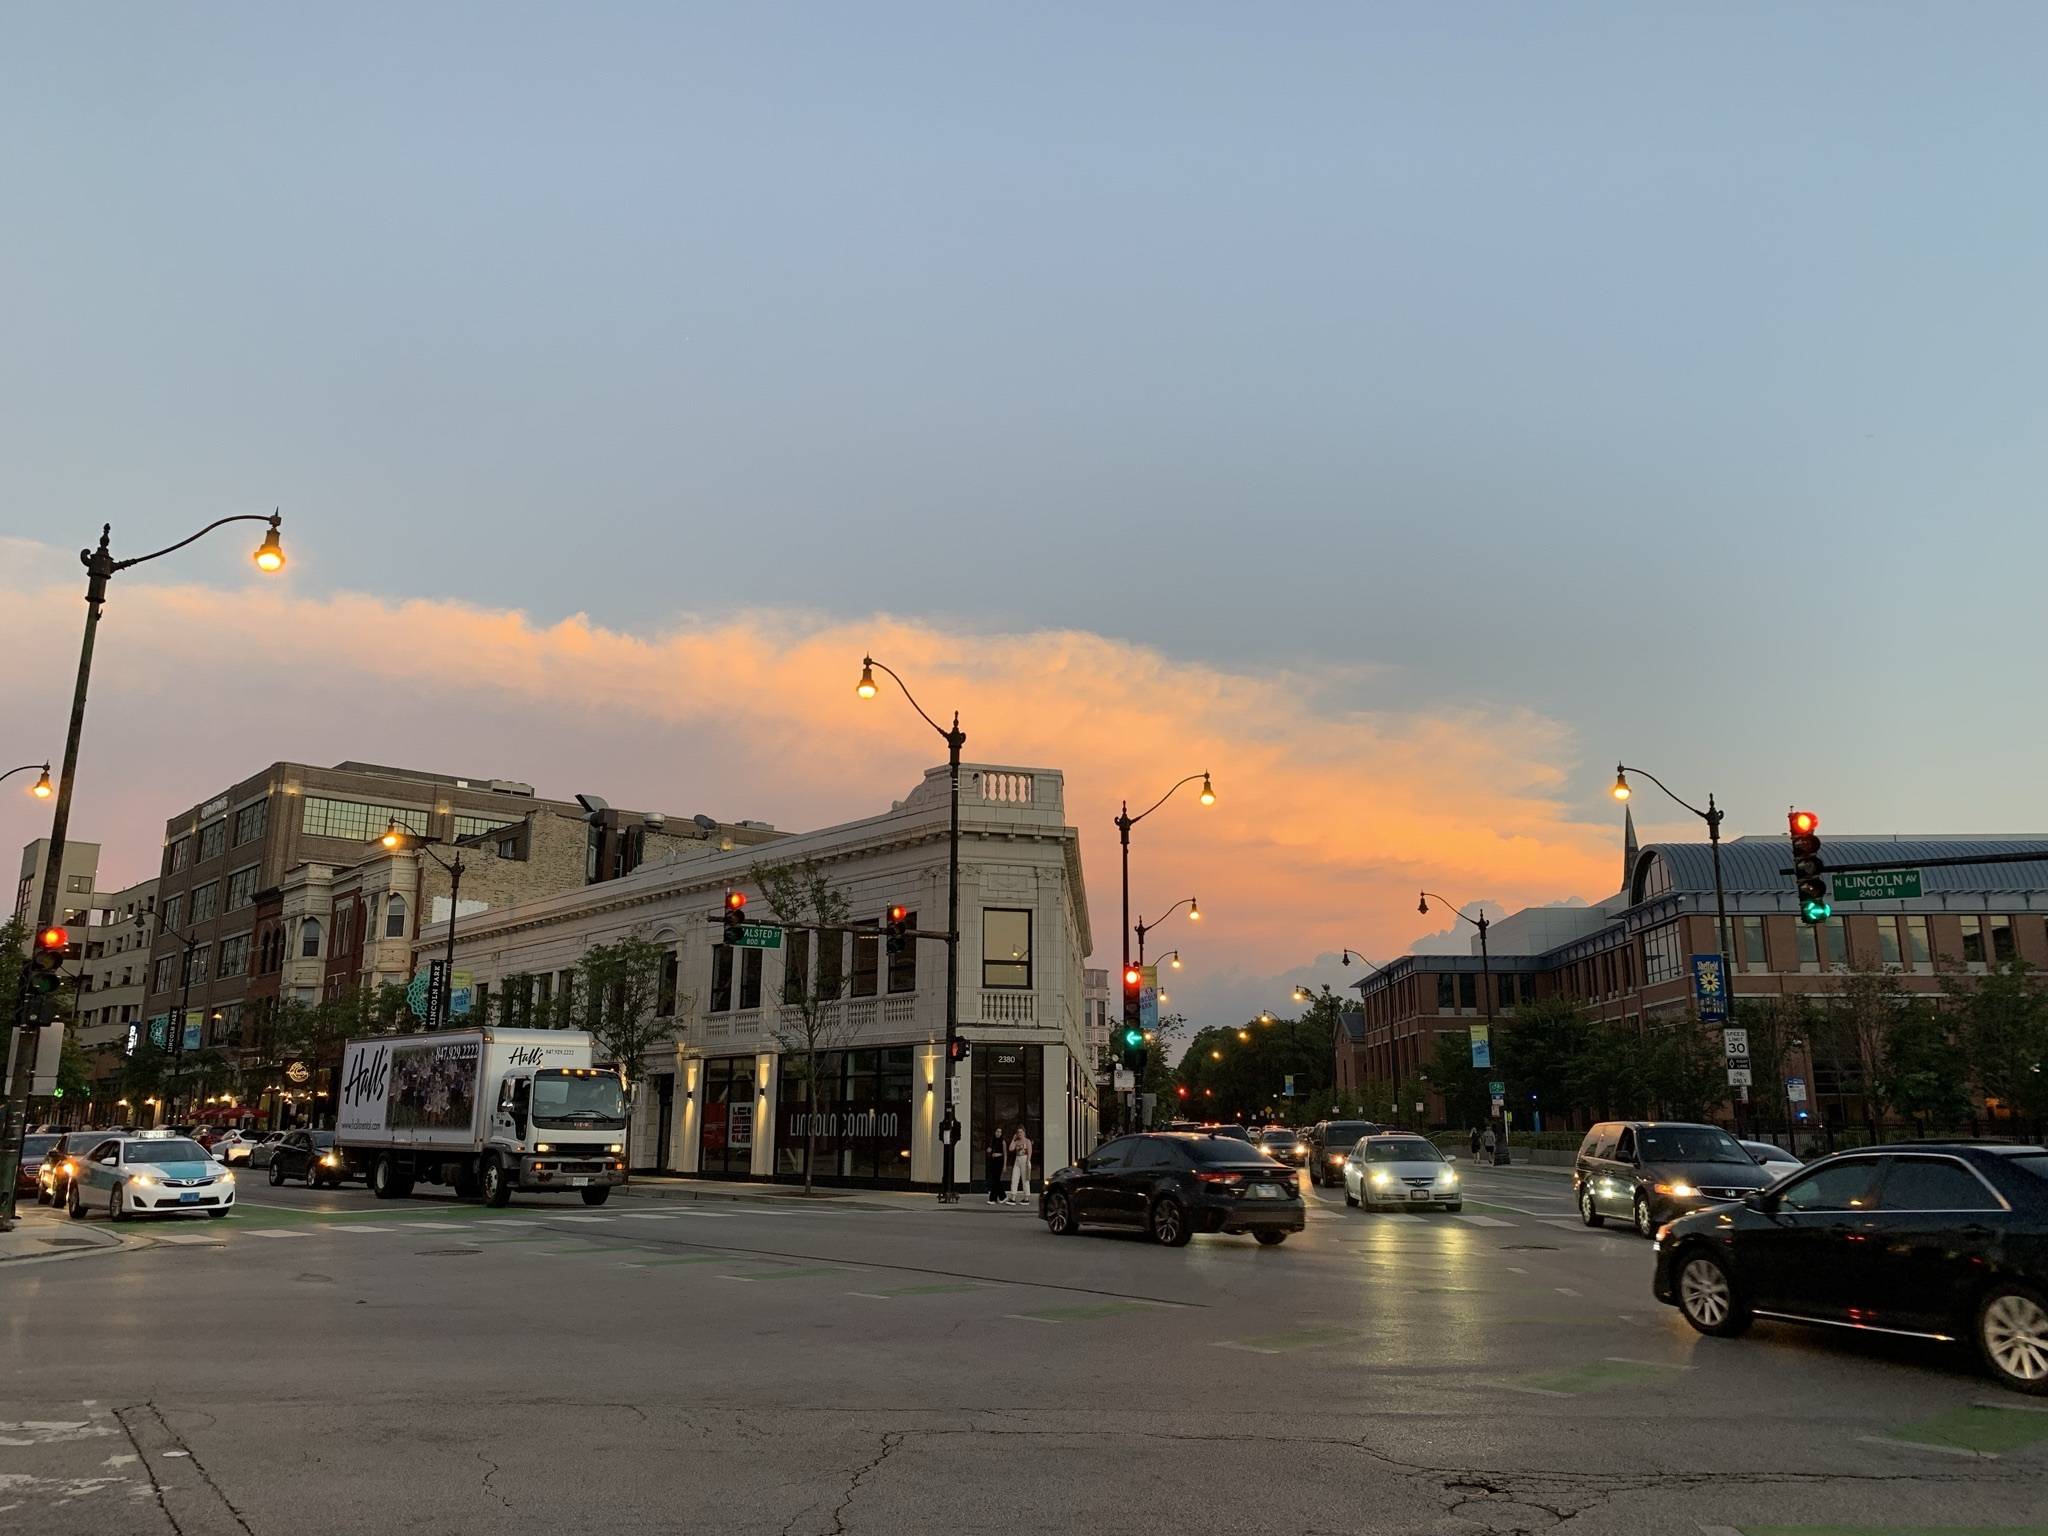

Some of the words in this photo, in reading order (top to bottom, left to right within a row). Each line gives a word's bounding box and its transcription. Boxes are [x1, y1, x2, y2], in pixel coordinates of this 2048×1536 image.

[1835, 879, 1841, 887] N
[1844, 875, 1903, 888] LINCOLN
[1905, 874, 1917, 883] AV
[1859, 889, 1883, 897] 2400
[743, 928, 773, 939] ALSTED
[433, 965, 441, 987] PARK
[430, 988, 439, 1026] LINCOLN
[167, 1027, 176, 1053] LINCOLN
[1728, 1043, 1746, 1054] 30
[435, 1044, 479, 1061] 847.929.2222
[790, 1113, 837, 1137] LINCOLN
